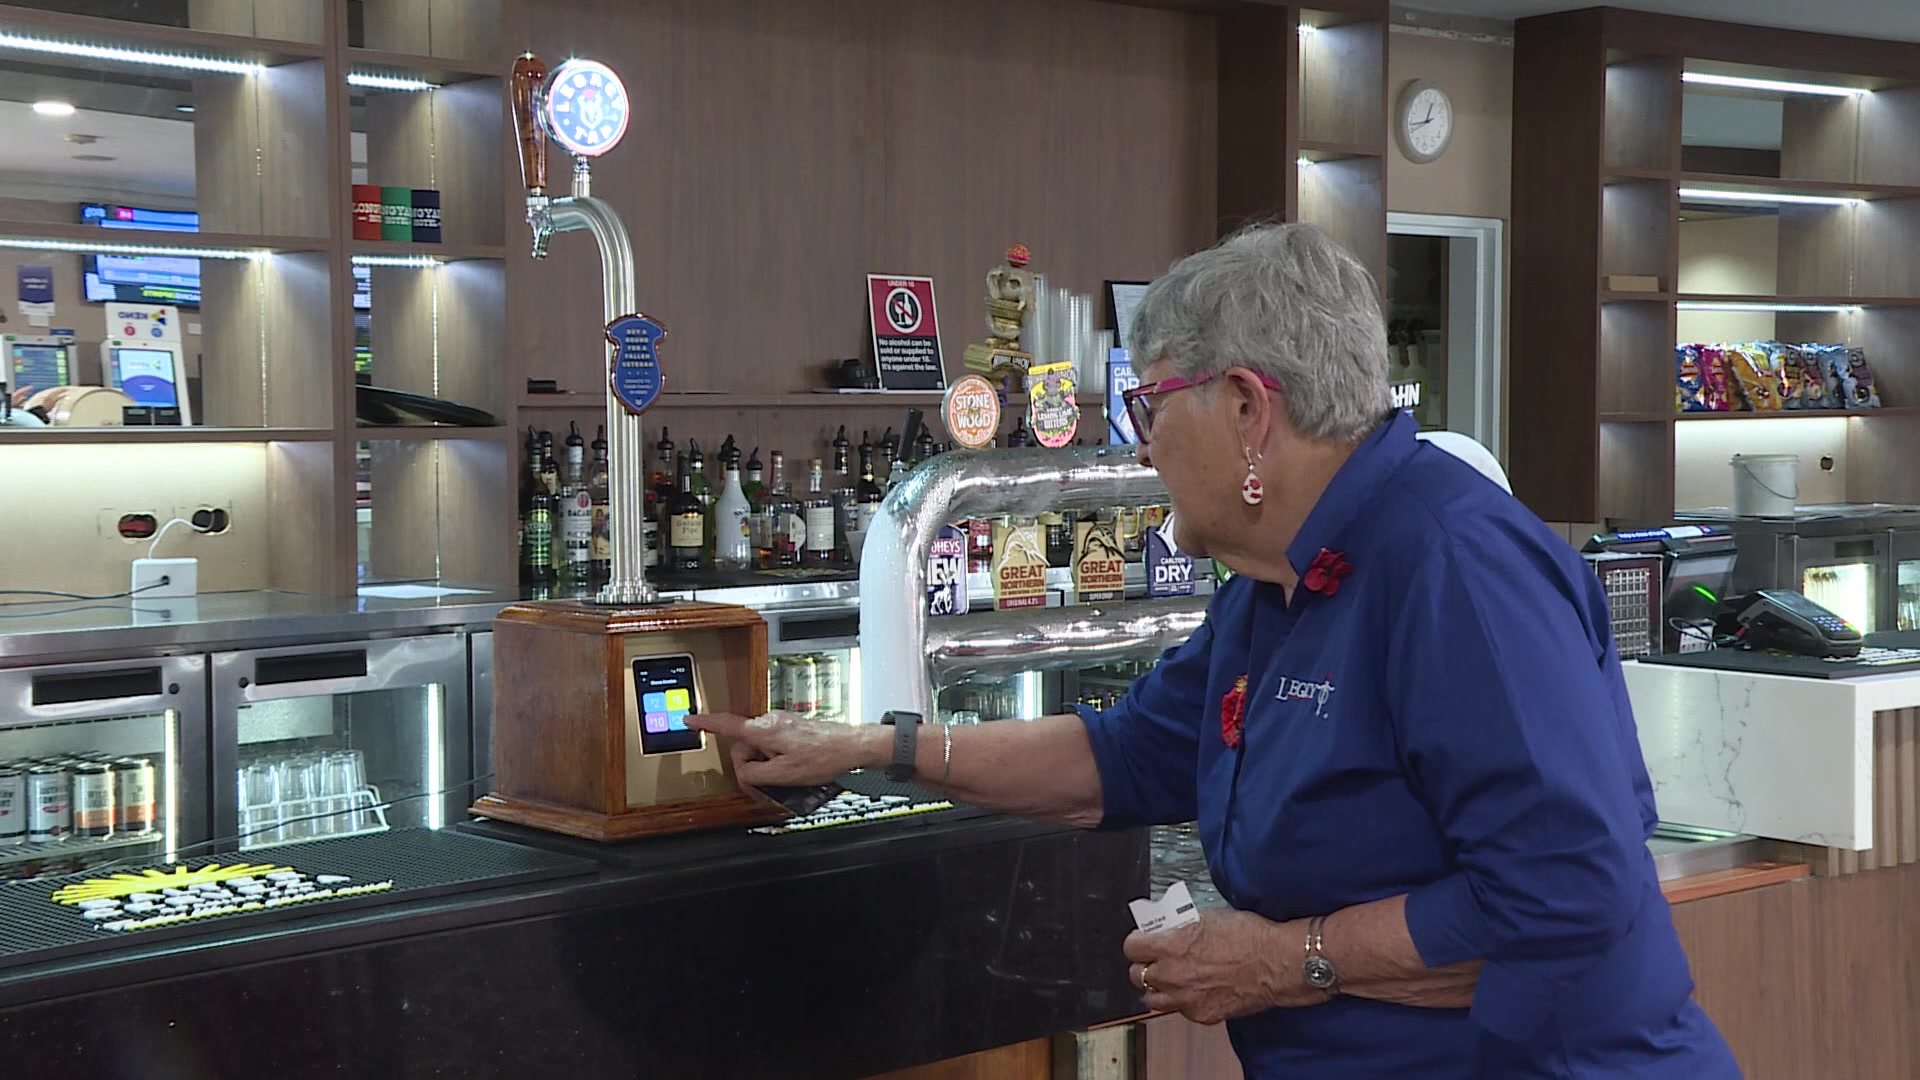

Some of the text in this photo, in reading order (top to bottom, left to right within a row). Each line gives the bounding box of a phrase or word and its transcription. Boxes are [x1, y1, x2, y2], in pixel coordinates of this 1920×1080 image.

[574, 124, 613, 145] TAP
[923, 339, 931, 347] be
[902, 347, 926, 356] supplied
[881, 356, 903, 364] anyone
[892, 364, 914, 372] against
[955, 393, 991, 410] STONE
[956, 413, 991, 428] WOOD
[1160, 557, 1186, 565] CARLTON
[1000, 565, 1044, 579] GREAT
[1080, 560, 1122, 574] GREAT
[1155, 564, 1193, 582] DRY
[1001, 579, 1044, 590] NORTHERN
[1080, 574, 1122, 584] NORTHERN
[649, 717, 665, 728] $10
